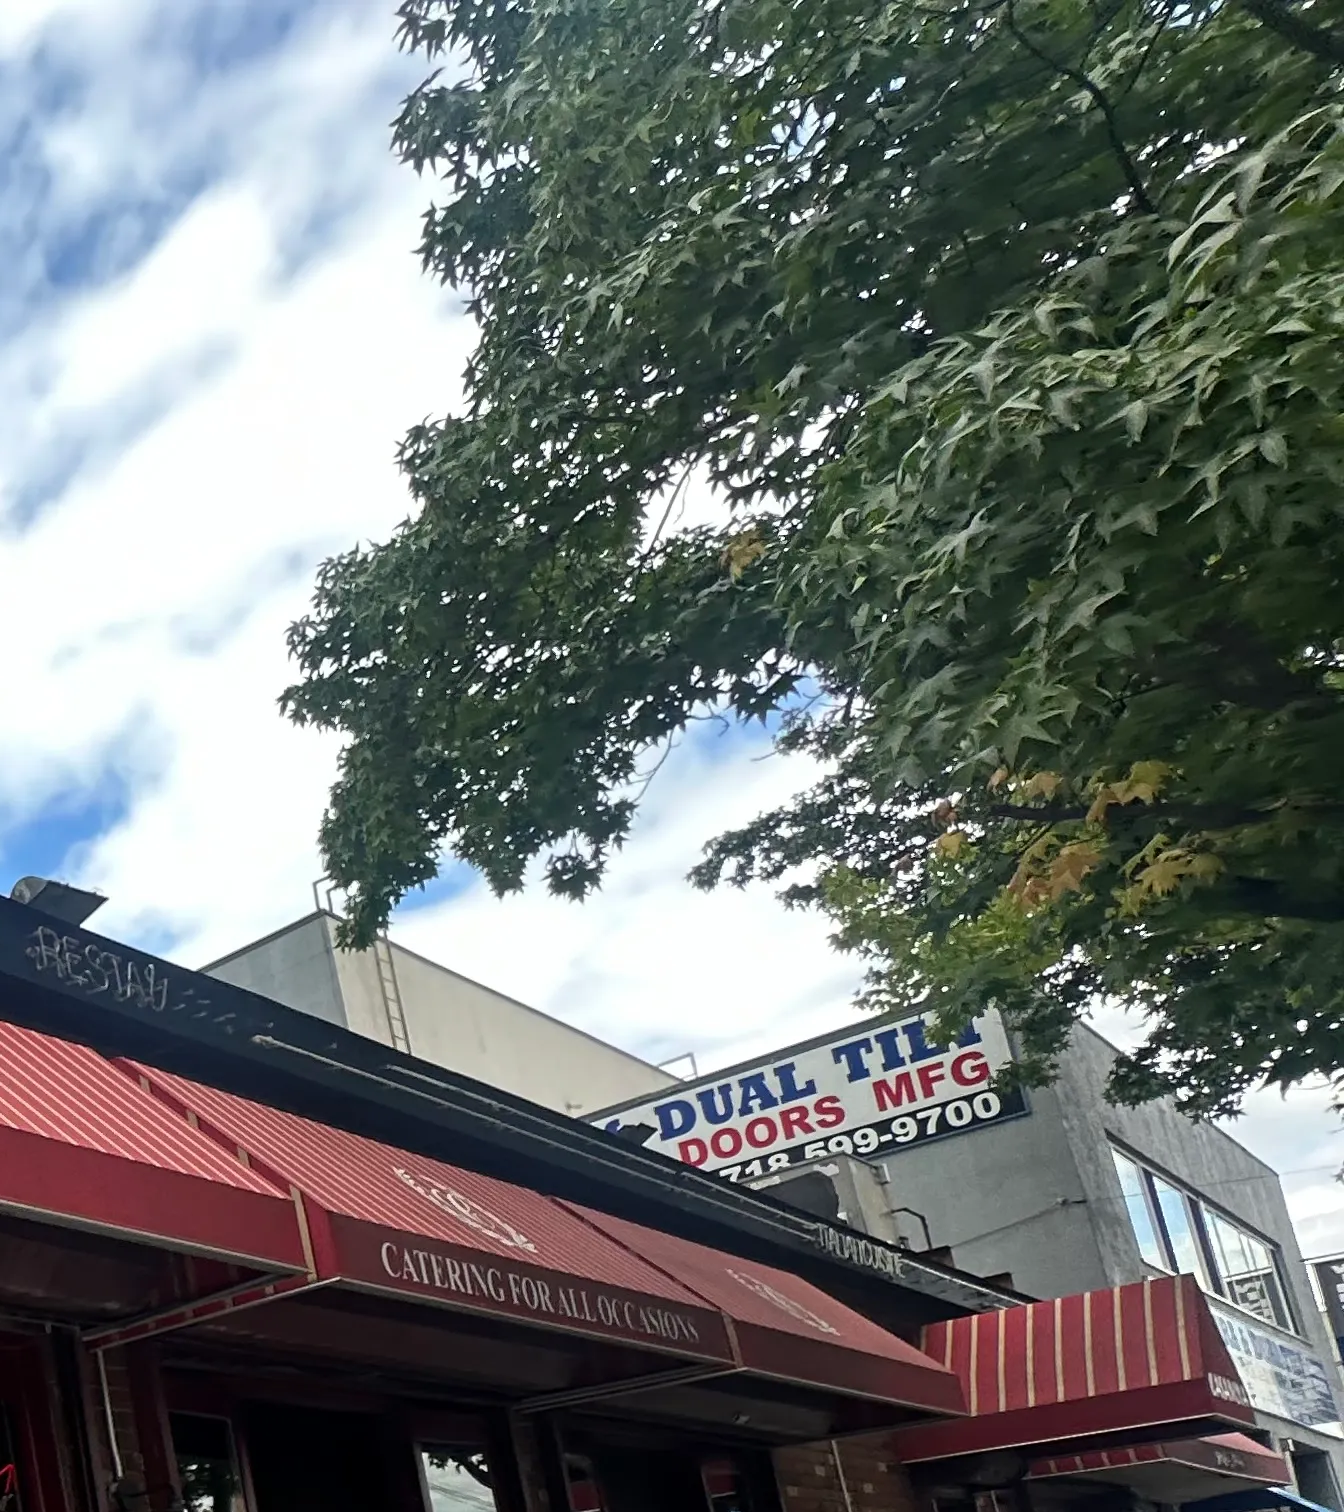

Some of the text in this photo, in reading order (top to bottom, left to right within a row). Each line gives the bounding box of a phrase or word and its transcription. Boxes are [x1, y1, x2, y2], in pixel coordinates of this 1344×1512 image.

[653, 1062, 818, 1142] DUAL
[678, 1051, 991, 1168] DOORS MFG
[804, 1090, 1002, 1160] 599-9700
[380, 1241, 700, 1343] CATERING FOR ALL OCCASIONS
